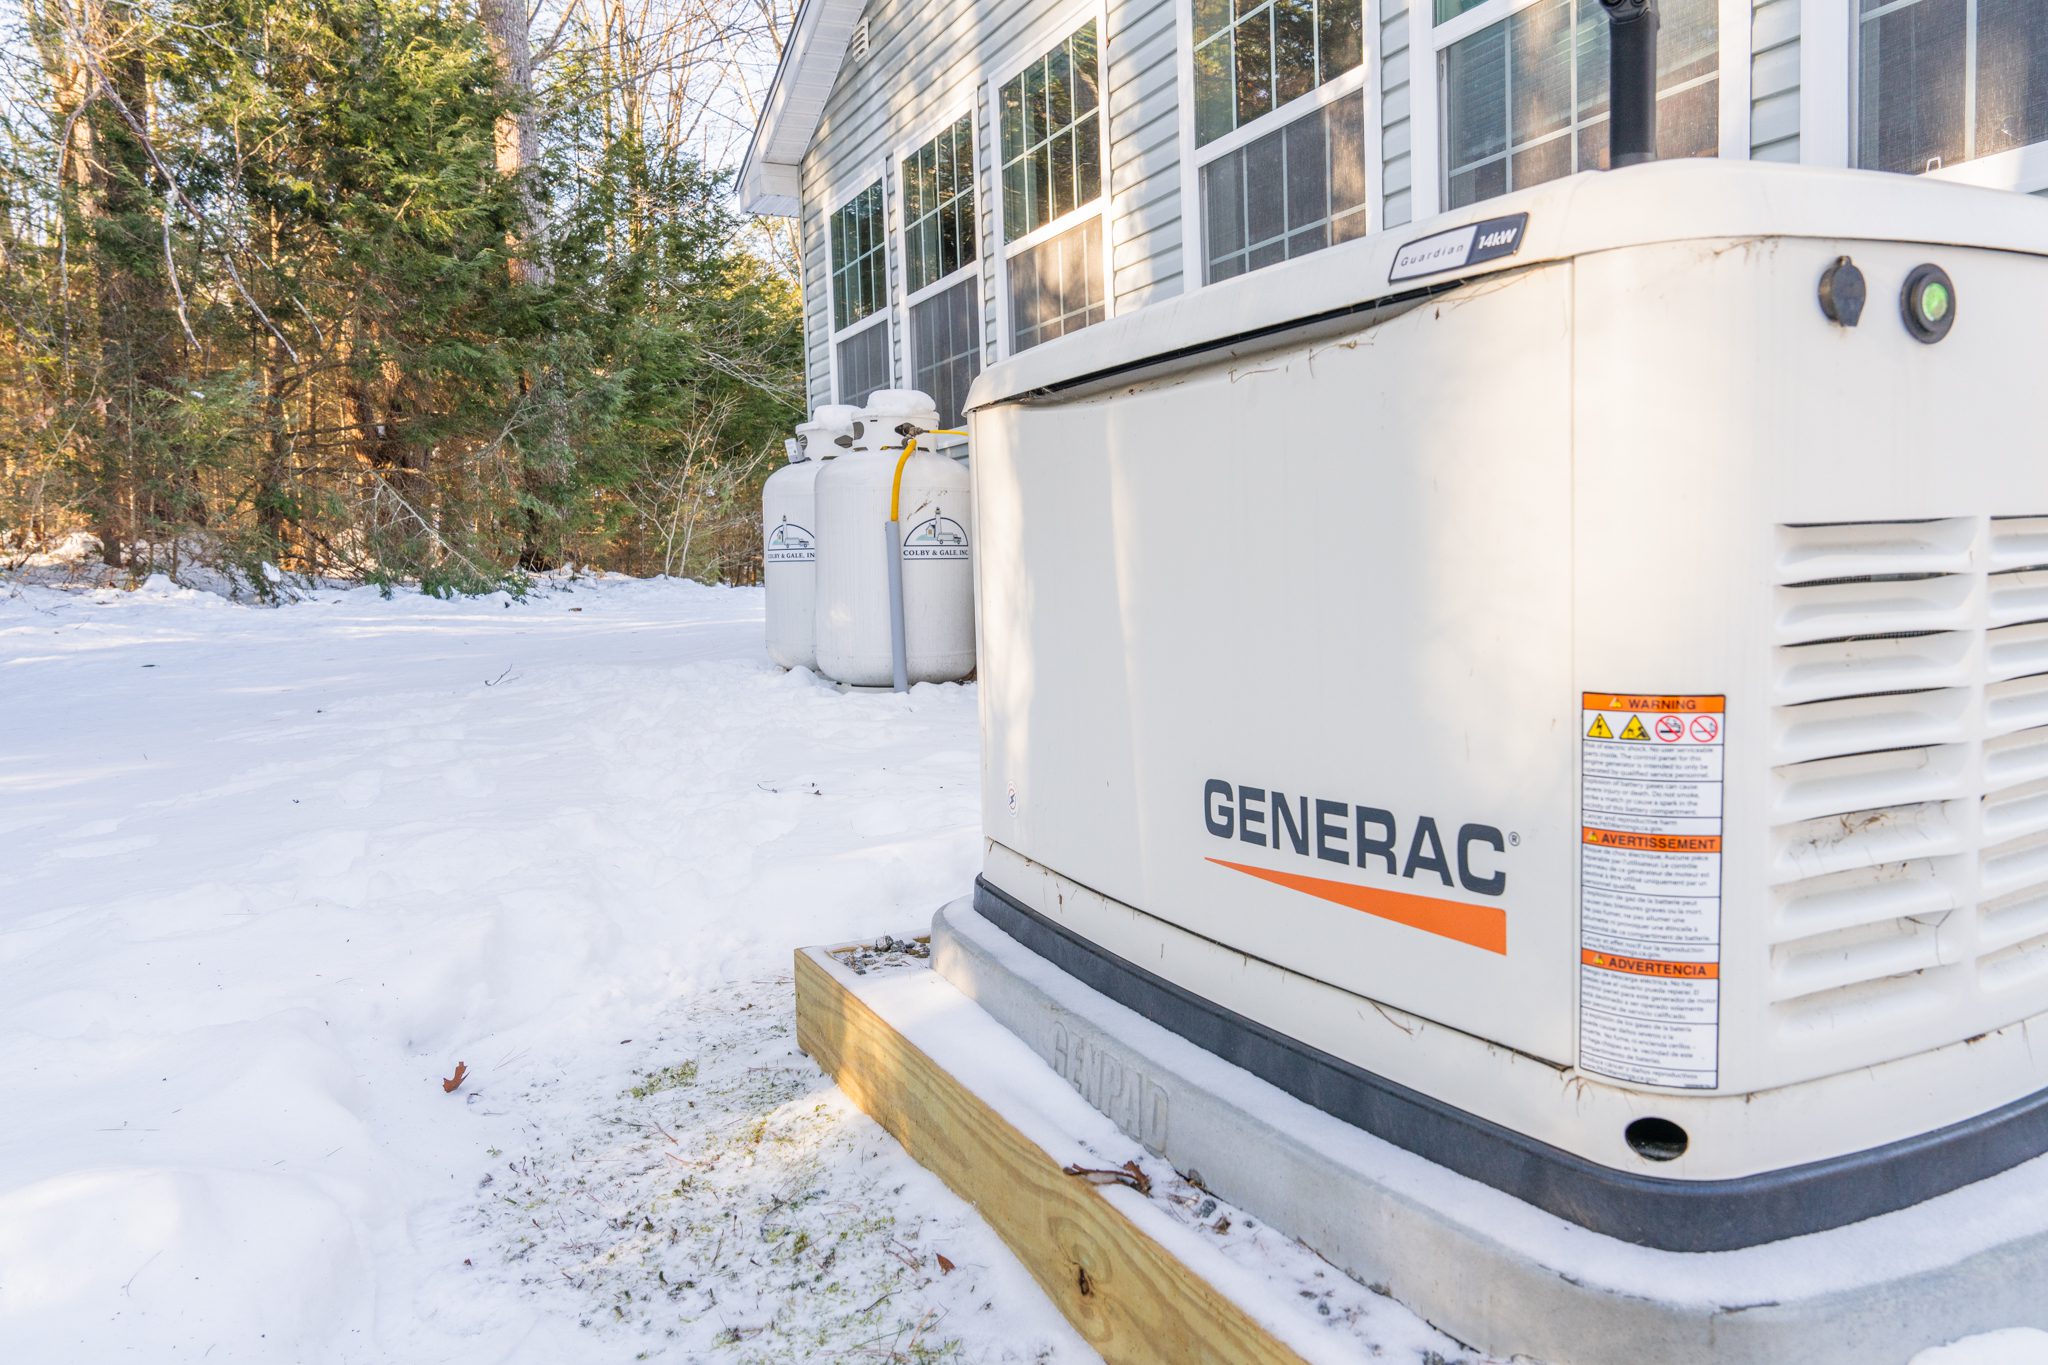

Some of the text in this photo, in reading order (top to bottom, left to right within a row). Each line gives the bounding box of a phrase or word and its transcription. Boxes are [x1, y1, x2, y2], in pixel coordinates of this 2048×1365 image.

[1400, 228, 1518, 267] Guardian 14kW
[1628, 699, 1697, 710] WARNING
[1601, 834, 1716, 849] AVERTISSEMENT
[1609, 958, 1707, 975] ADVERTENCIA
